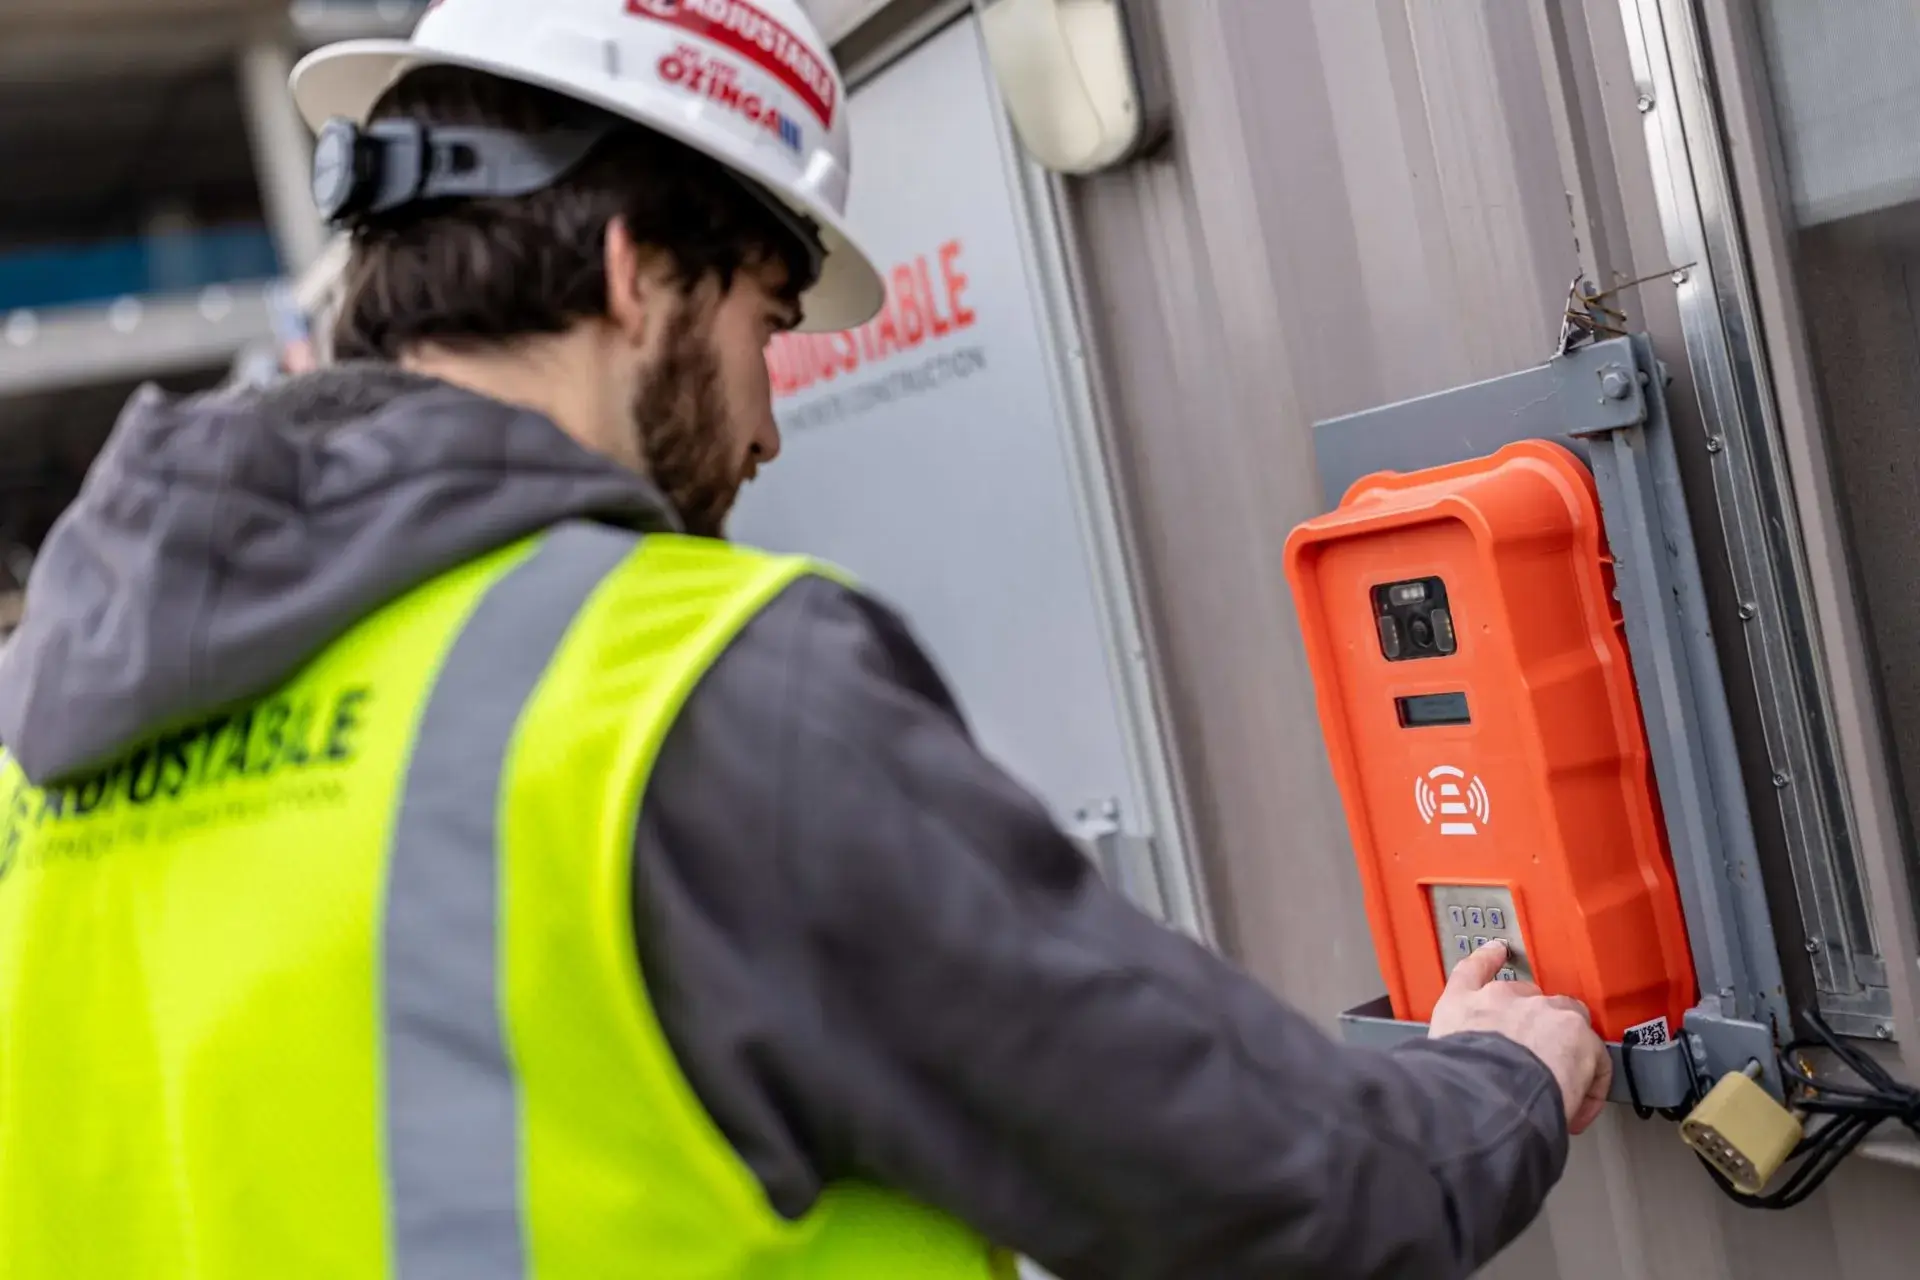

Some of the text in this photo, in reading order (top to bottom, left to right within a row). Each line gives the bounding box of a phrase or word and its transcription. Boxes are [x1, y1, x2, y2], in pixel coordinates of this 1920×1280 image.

[657, 53, 781, 138] OZINGA
[1452, 911, 1499, 925] 1 2 3
